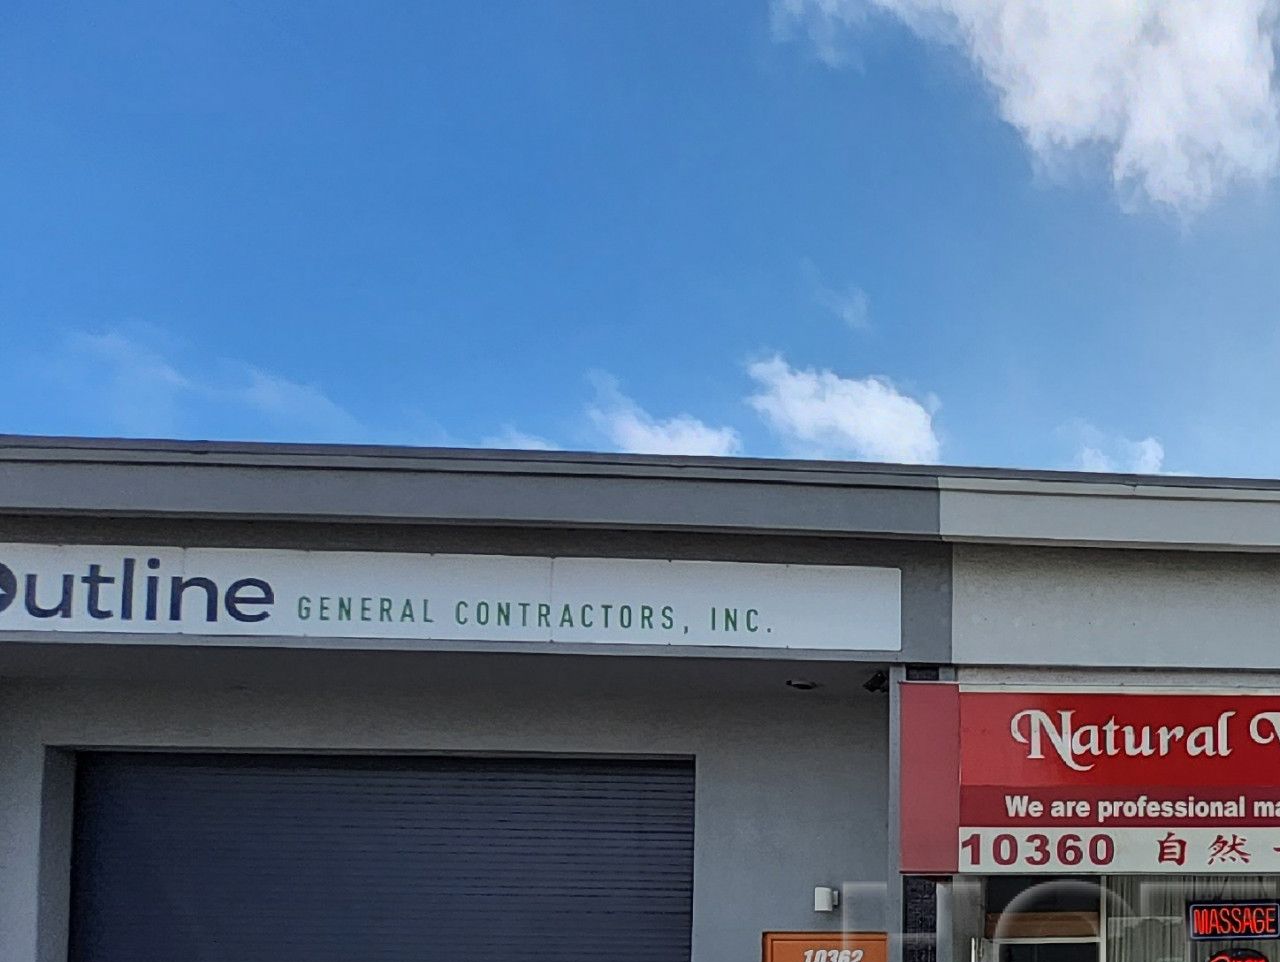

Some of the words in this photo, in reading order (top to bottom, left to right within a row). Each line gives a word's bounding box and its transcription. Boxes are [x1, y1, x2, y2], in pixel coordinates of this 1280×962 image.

[297, 596, 435, 623] GENERAL
[455, 600, 689, 634] CONTRACTORS,
[710, 607, 773, 633] INC.
[1010, 709, 1237, 772] Natural
[1005, 795, 1044, 818] We
[1050, 800, 1091, 818] are
[1098, 796, 1246, 823] professional
[961, 833, 1115, 867] 10360
[1193, 907, 1277, 935] MASSAGE
